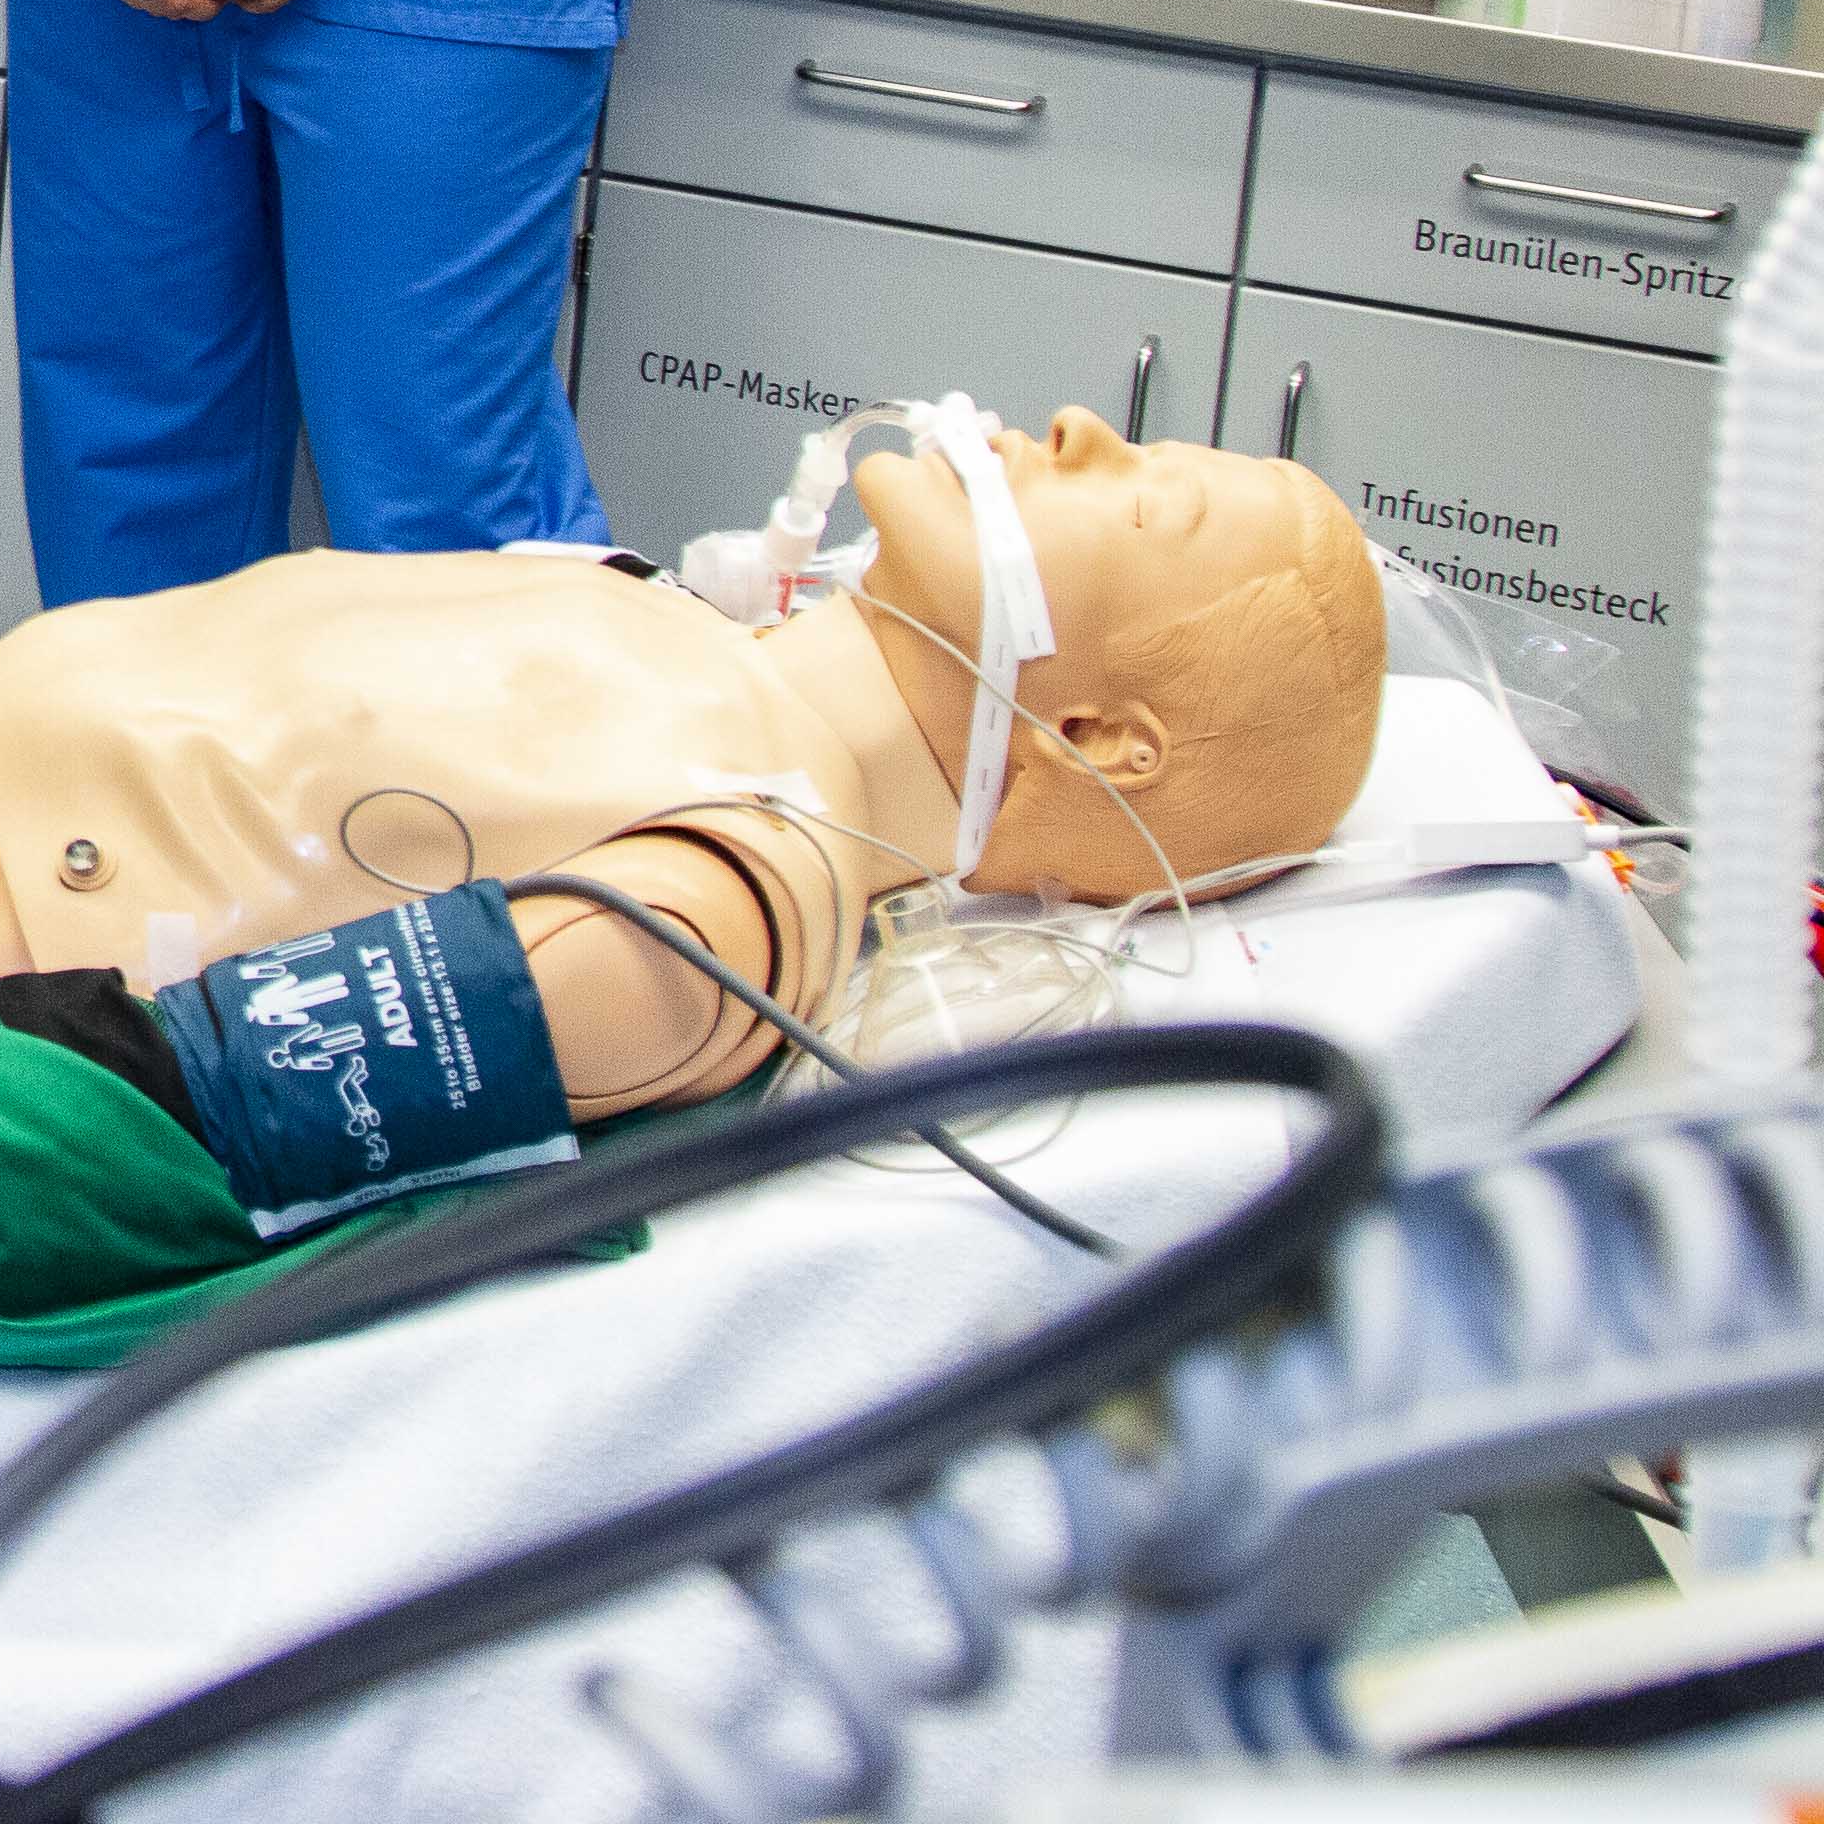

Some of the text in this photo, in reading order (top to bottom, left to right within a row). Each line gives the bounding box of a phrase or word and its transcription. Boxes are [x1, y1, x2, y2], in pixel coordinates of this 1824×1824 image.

[1414, 219, 1736, 300] Braunülen-Spritz
[1361, 482, 1559, 548] Infusionen
[359, 946, 418, 1047] ADULT
[456, 1027, 483, 1092] Bladder
